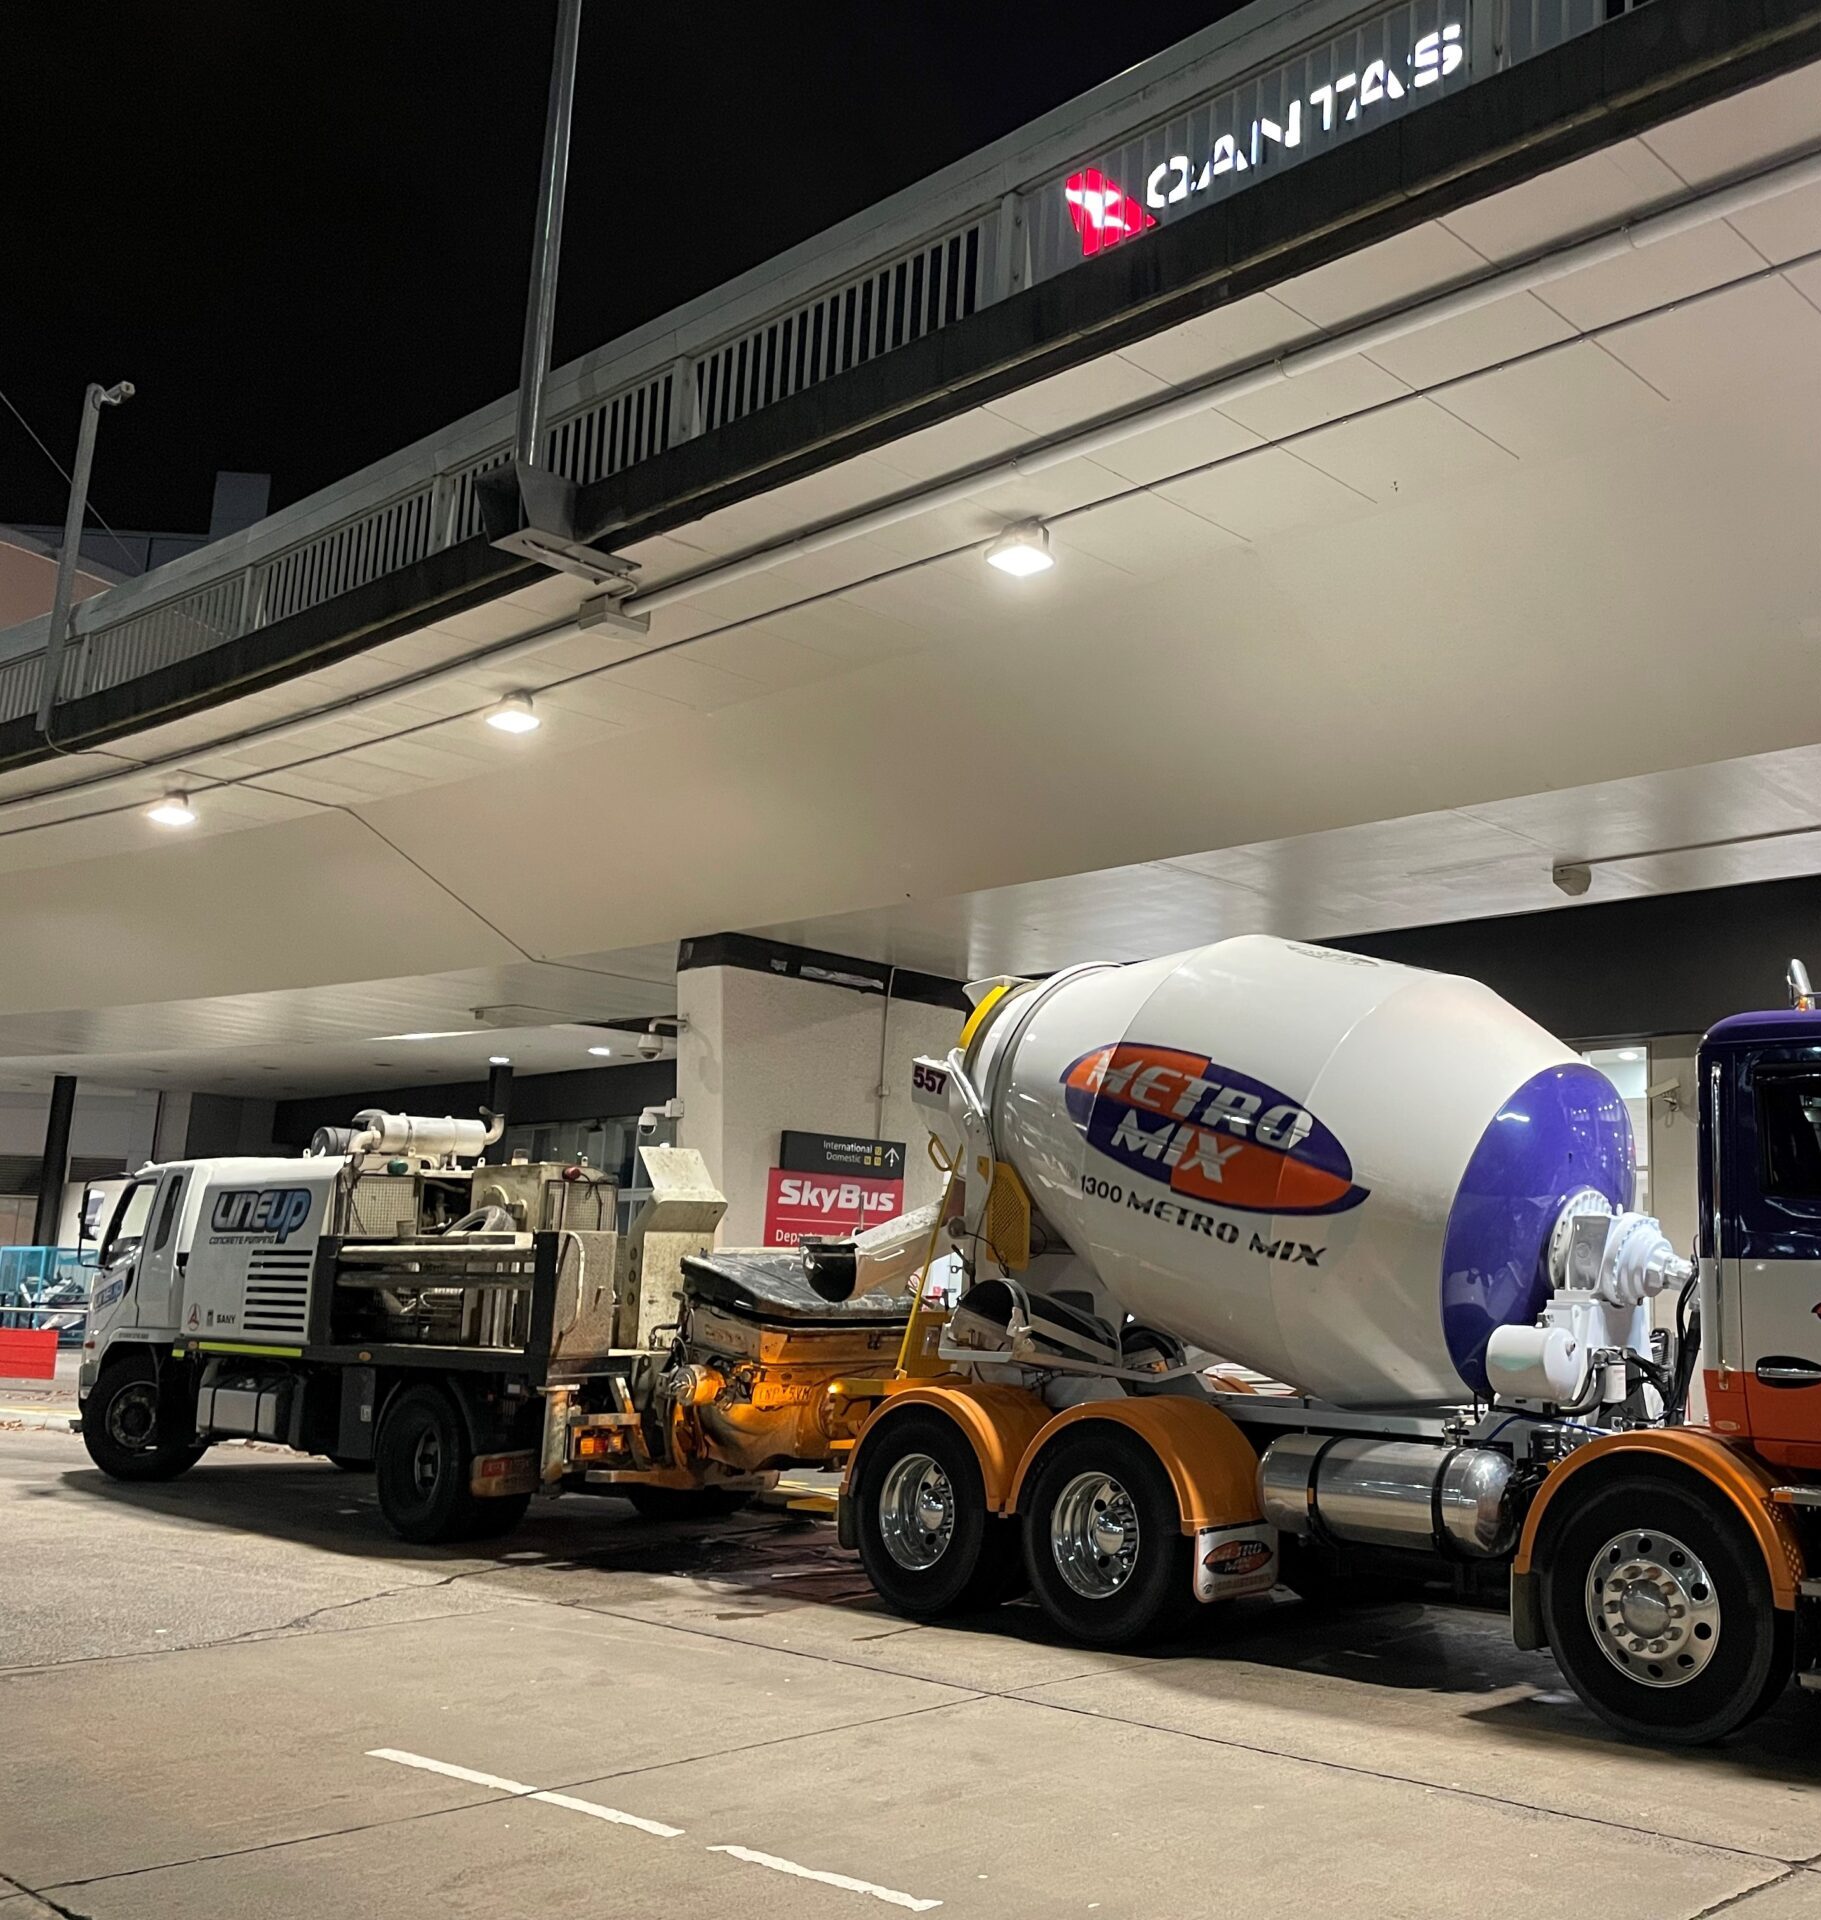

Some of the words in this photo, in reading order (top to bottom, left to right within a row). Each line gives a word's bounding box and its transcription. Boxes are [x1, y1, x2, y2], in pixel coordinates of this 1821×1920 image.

[1146, 23, 1463, 209] QANTAS
[913, 1065, 947, 1095] 557
[1086, 1049, 1314, 1150] METRO
[823, 1140, 872, 1154] International
[826, 1151, 861, 1163] Domestic
[1110, 1108, 1245, 1184] MIX
[777, 1178, 896, 1214] SkyBus
[1080, 1174, 1122, 1203] 1300
[1126, 1191, 1240, 1244] METRO
[1248, 1232, 1327, 1267] MIX
[209, 1235, 244, 1245] CONCRETE
[244, 1235, 275, 1245] PUMPING
[216, 1314, 236, 1324] SANY
